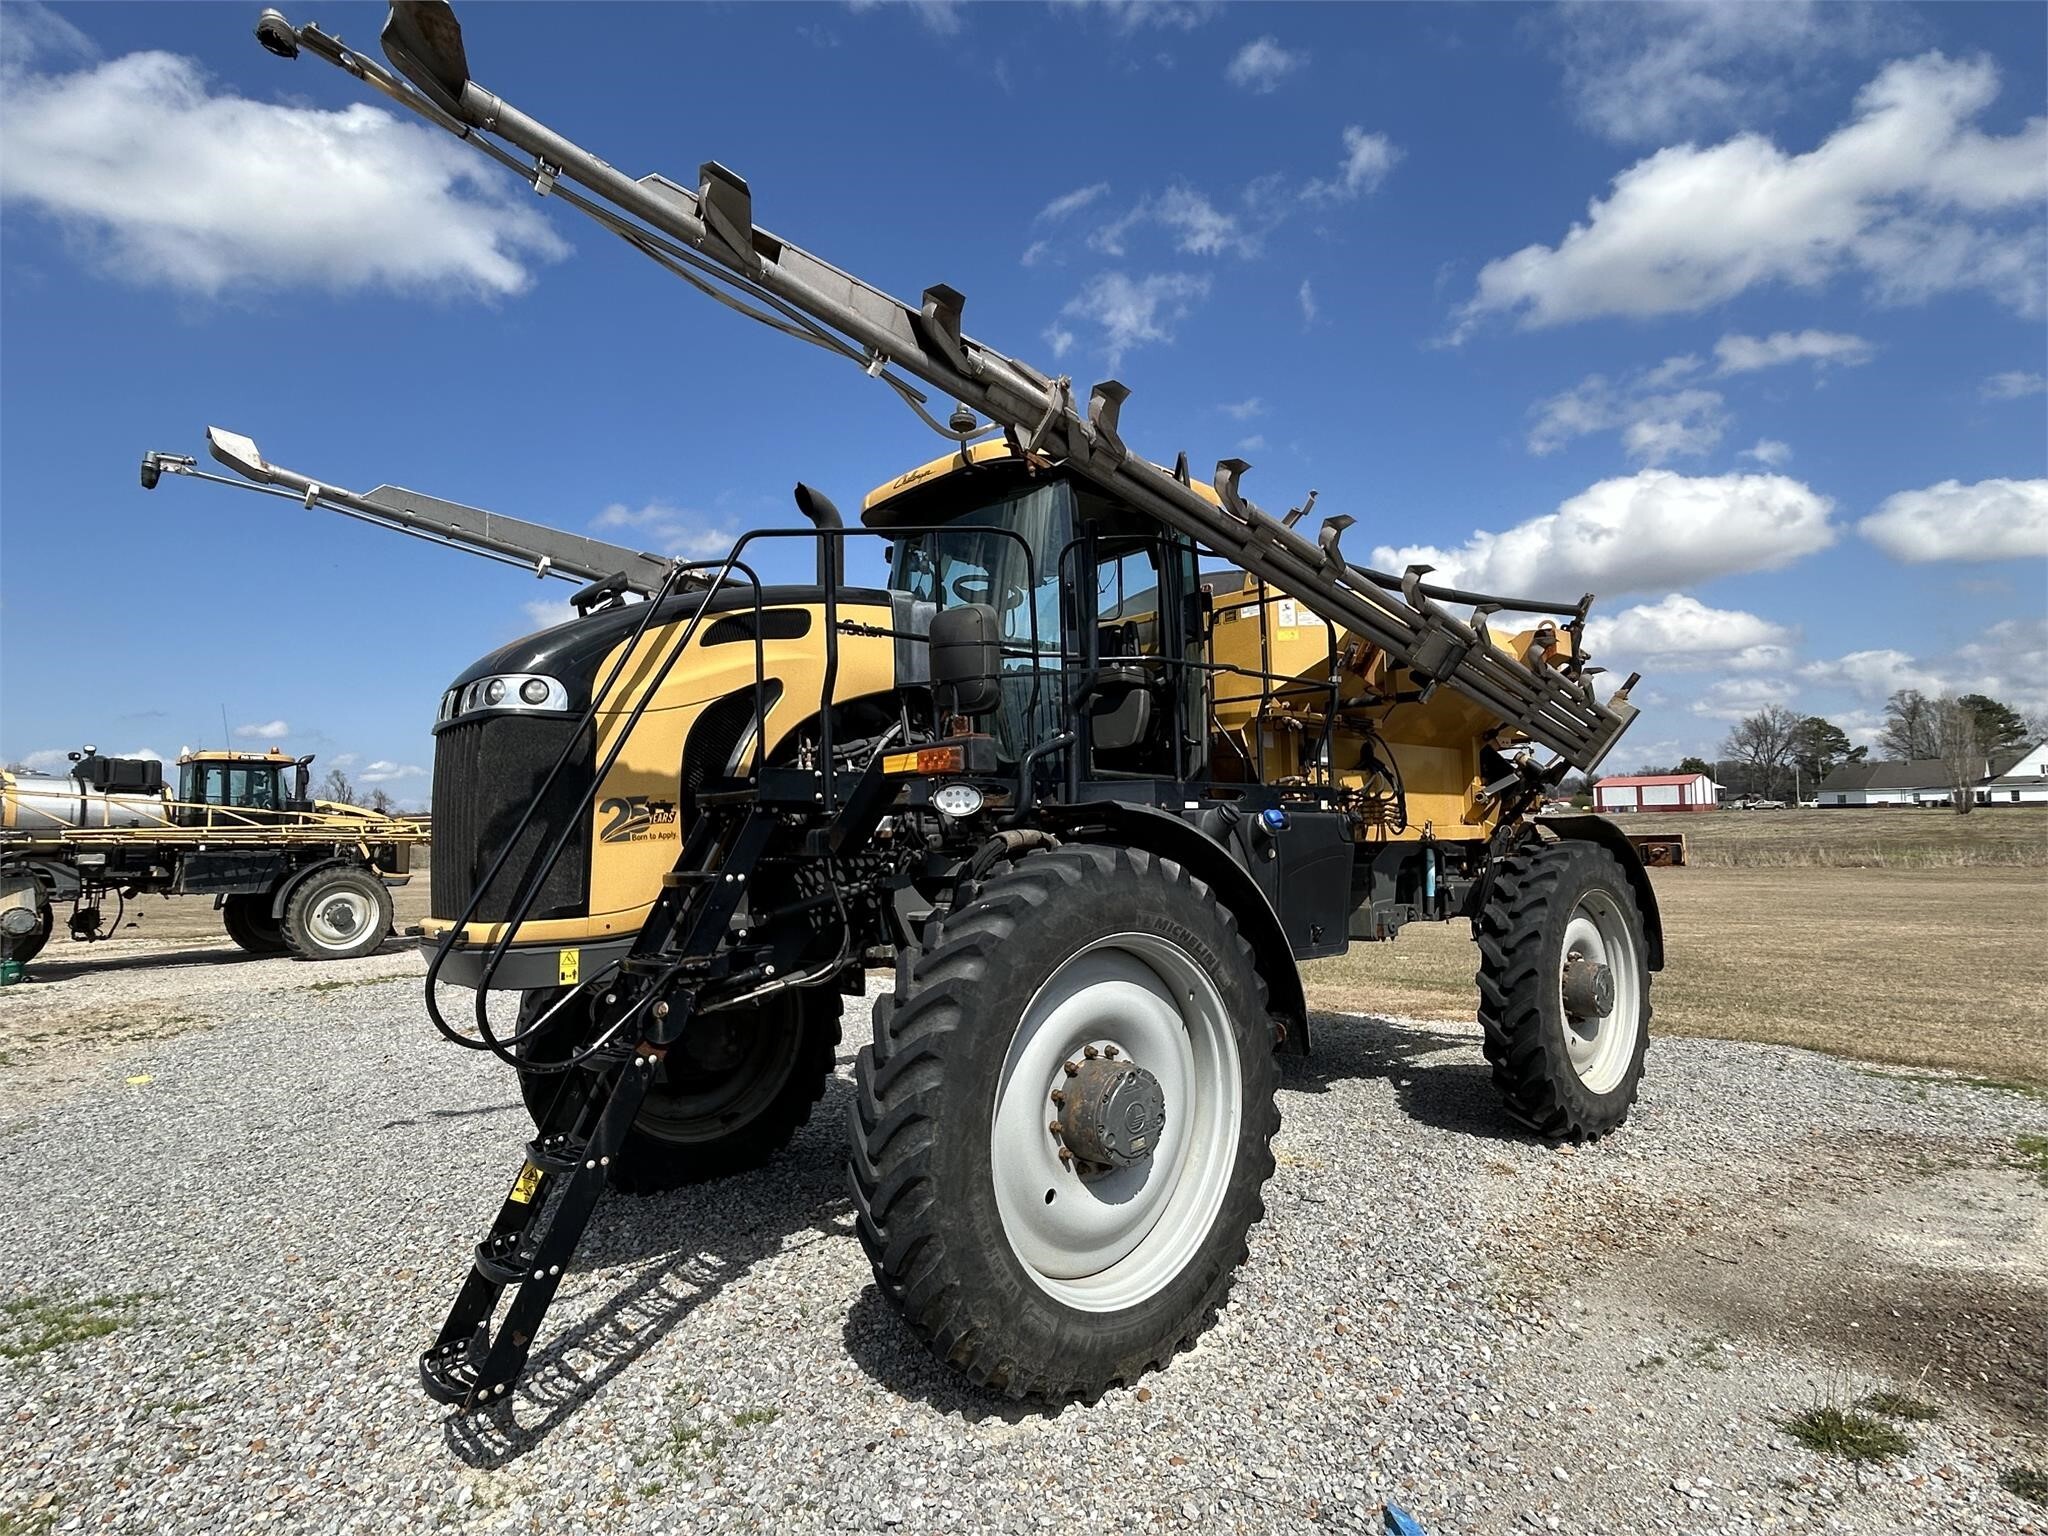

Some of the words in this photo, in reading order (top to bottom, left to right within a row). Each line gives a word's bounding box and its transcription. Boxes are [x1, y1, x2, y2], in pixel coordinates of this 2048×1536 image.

[599, 795, 649, 843] 25
[649, 811, 676, 825] YEARS
[631, 832, 648, 841] Born
[1153, 917, 1218, 968] MICHELIN
